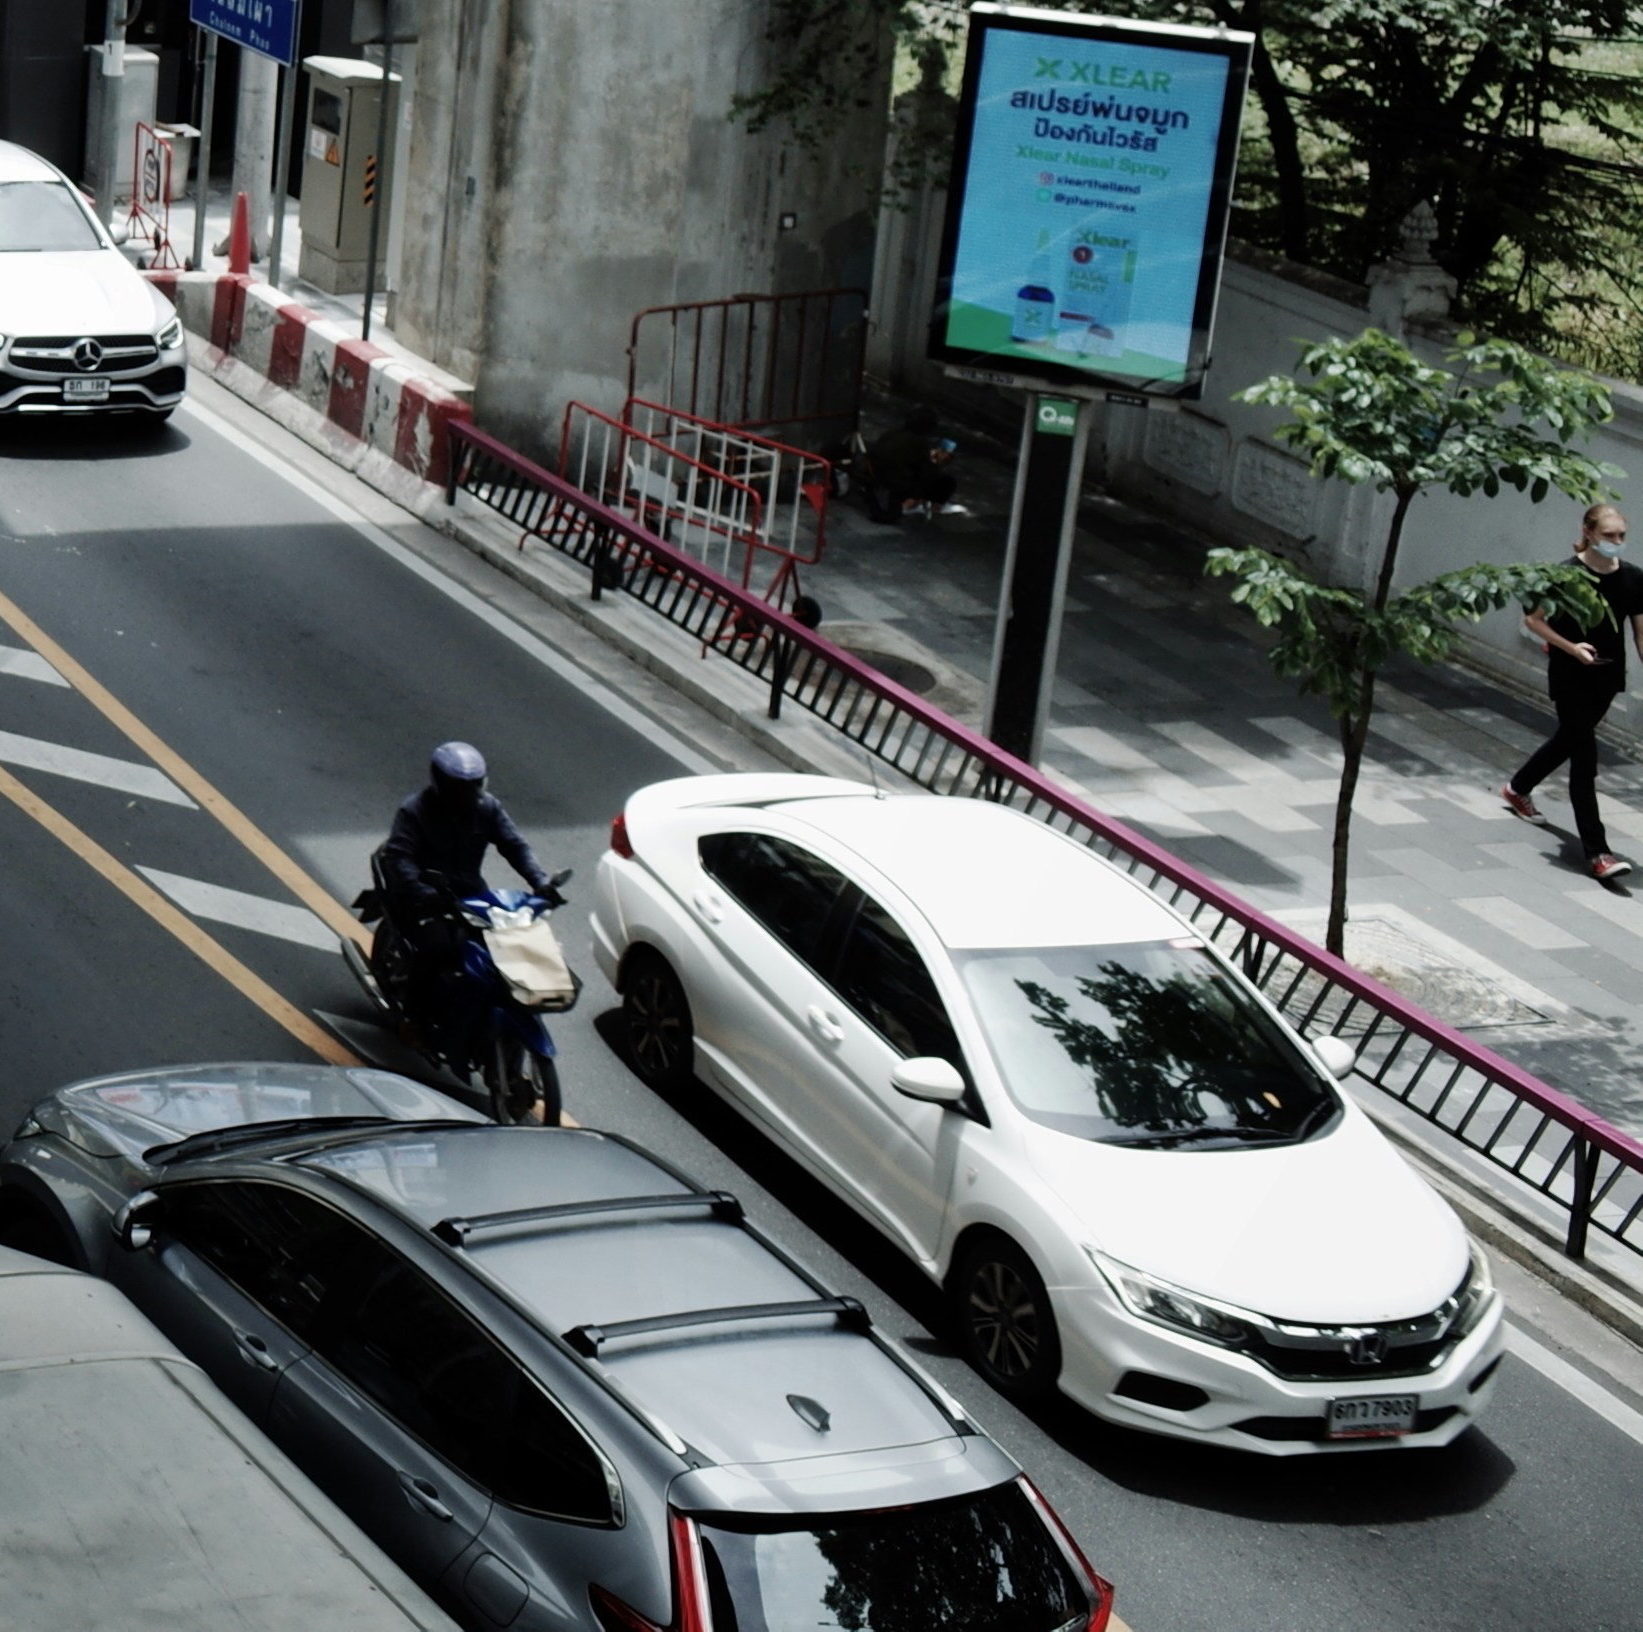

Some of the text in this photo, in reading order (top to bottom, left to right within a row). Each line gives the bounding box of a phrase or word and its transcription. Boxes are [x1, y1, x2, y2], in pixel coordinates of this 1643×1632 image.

[250, 28, 270, 51] Phao
[1068, 61, 1172, 93] XLEAR
[1010, 88, 1190, 136] สเปรย์พ่นจมูก
[1034, 117, 1159, 152] ป้องกันไวรัส
[1016, 144, 1171, 180] Xlear Nasal Spray
[1056, 175, 1142, 196] xlearthailand
